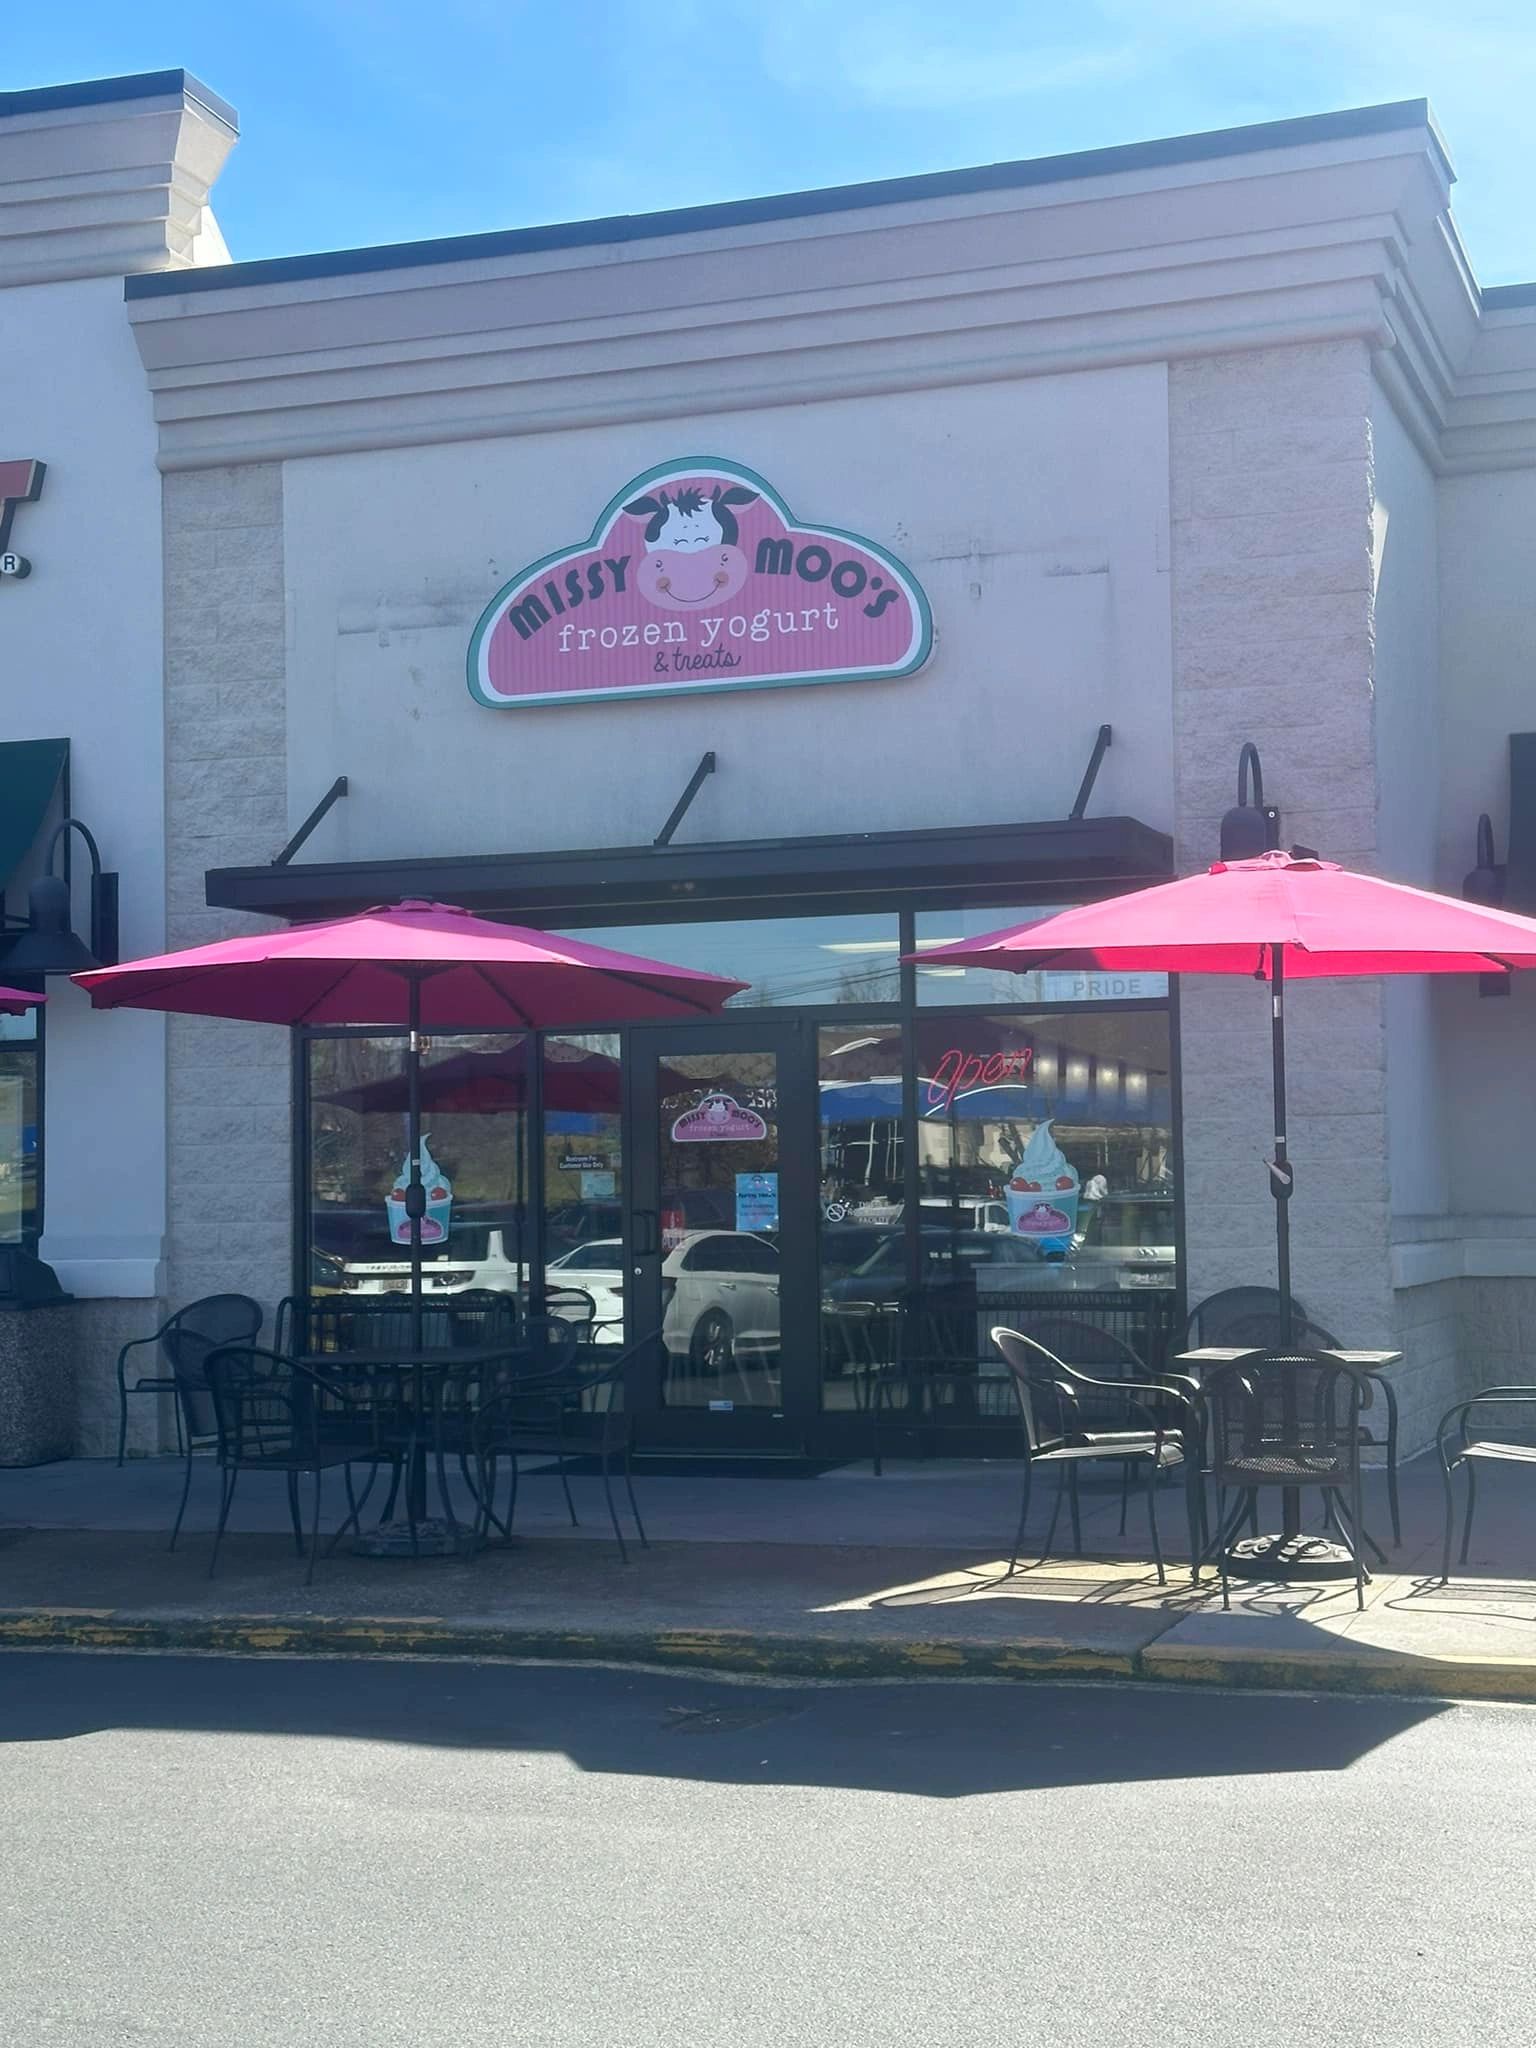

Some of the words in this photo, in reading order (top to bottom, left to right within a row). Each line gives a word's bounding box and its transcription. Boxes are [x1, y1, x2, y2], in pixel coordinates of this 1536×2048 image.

[508, 555, 632, 640] MISSY
[754, 537, 899, 618] MOO'S
[559, 621, 688, 652] frozen
[700, 602, 839, 647] yogurt
[654, 651, 669, 672] &
[672, 642, 742, 672] treats
[1073, 978, 1142, 996] PRIDE
[928, 1048, 1032, 1112] Open
